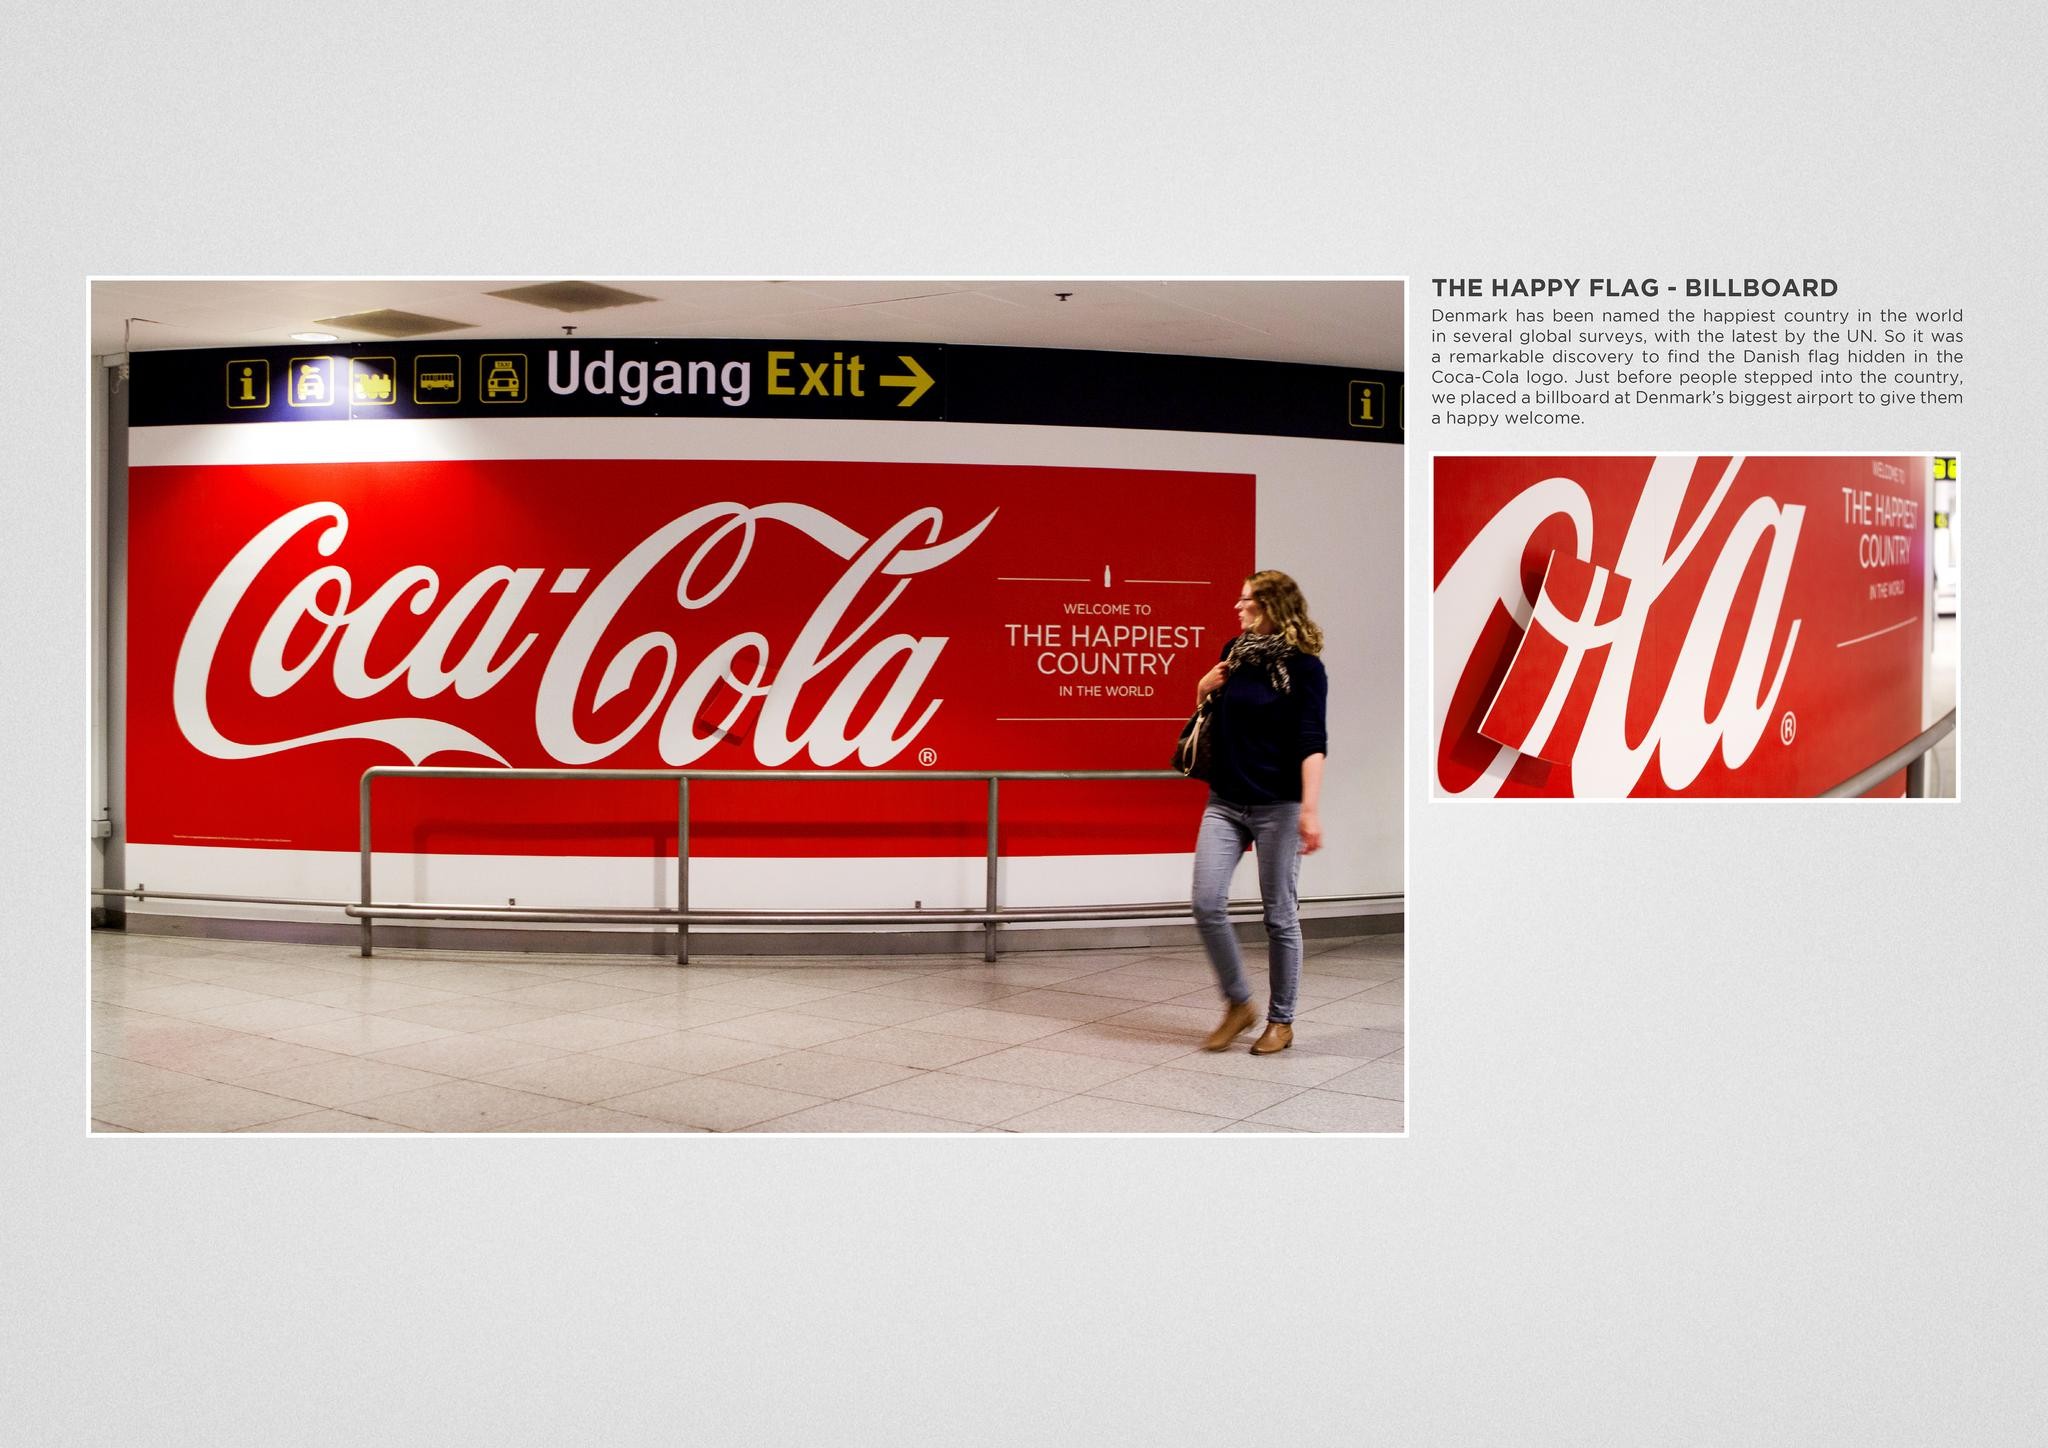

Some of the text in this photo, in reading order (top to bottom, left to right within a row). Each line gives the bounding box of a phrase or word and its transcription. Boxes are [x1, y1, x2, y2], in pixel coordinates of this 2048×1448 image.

[547, 350, 866, 407] Udgang Exit
[1842, 487, 1872, 526] THE
[1859, 533, 1912, 569] COUNTRY
[1063, 603, 1152, 616] WELCOME TO
[173, 500, 1001, 769] Coca-Cola
[1004, 624, 1206, 649] THE HAPPIEST
[1037, 652, 1176, 676] COUNTRY
[1059, 685, 1155, 698] IN THE WORLD
